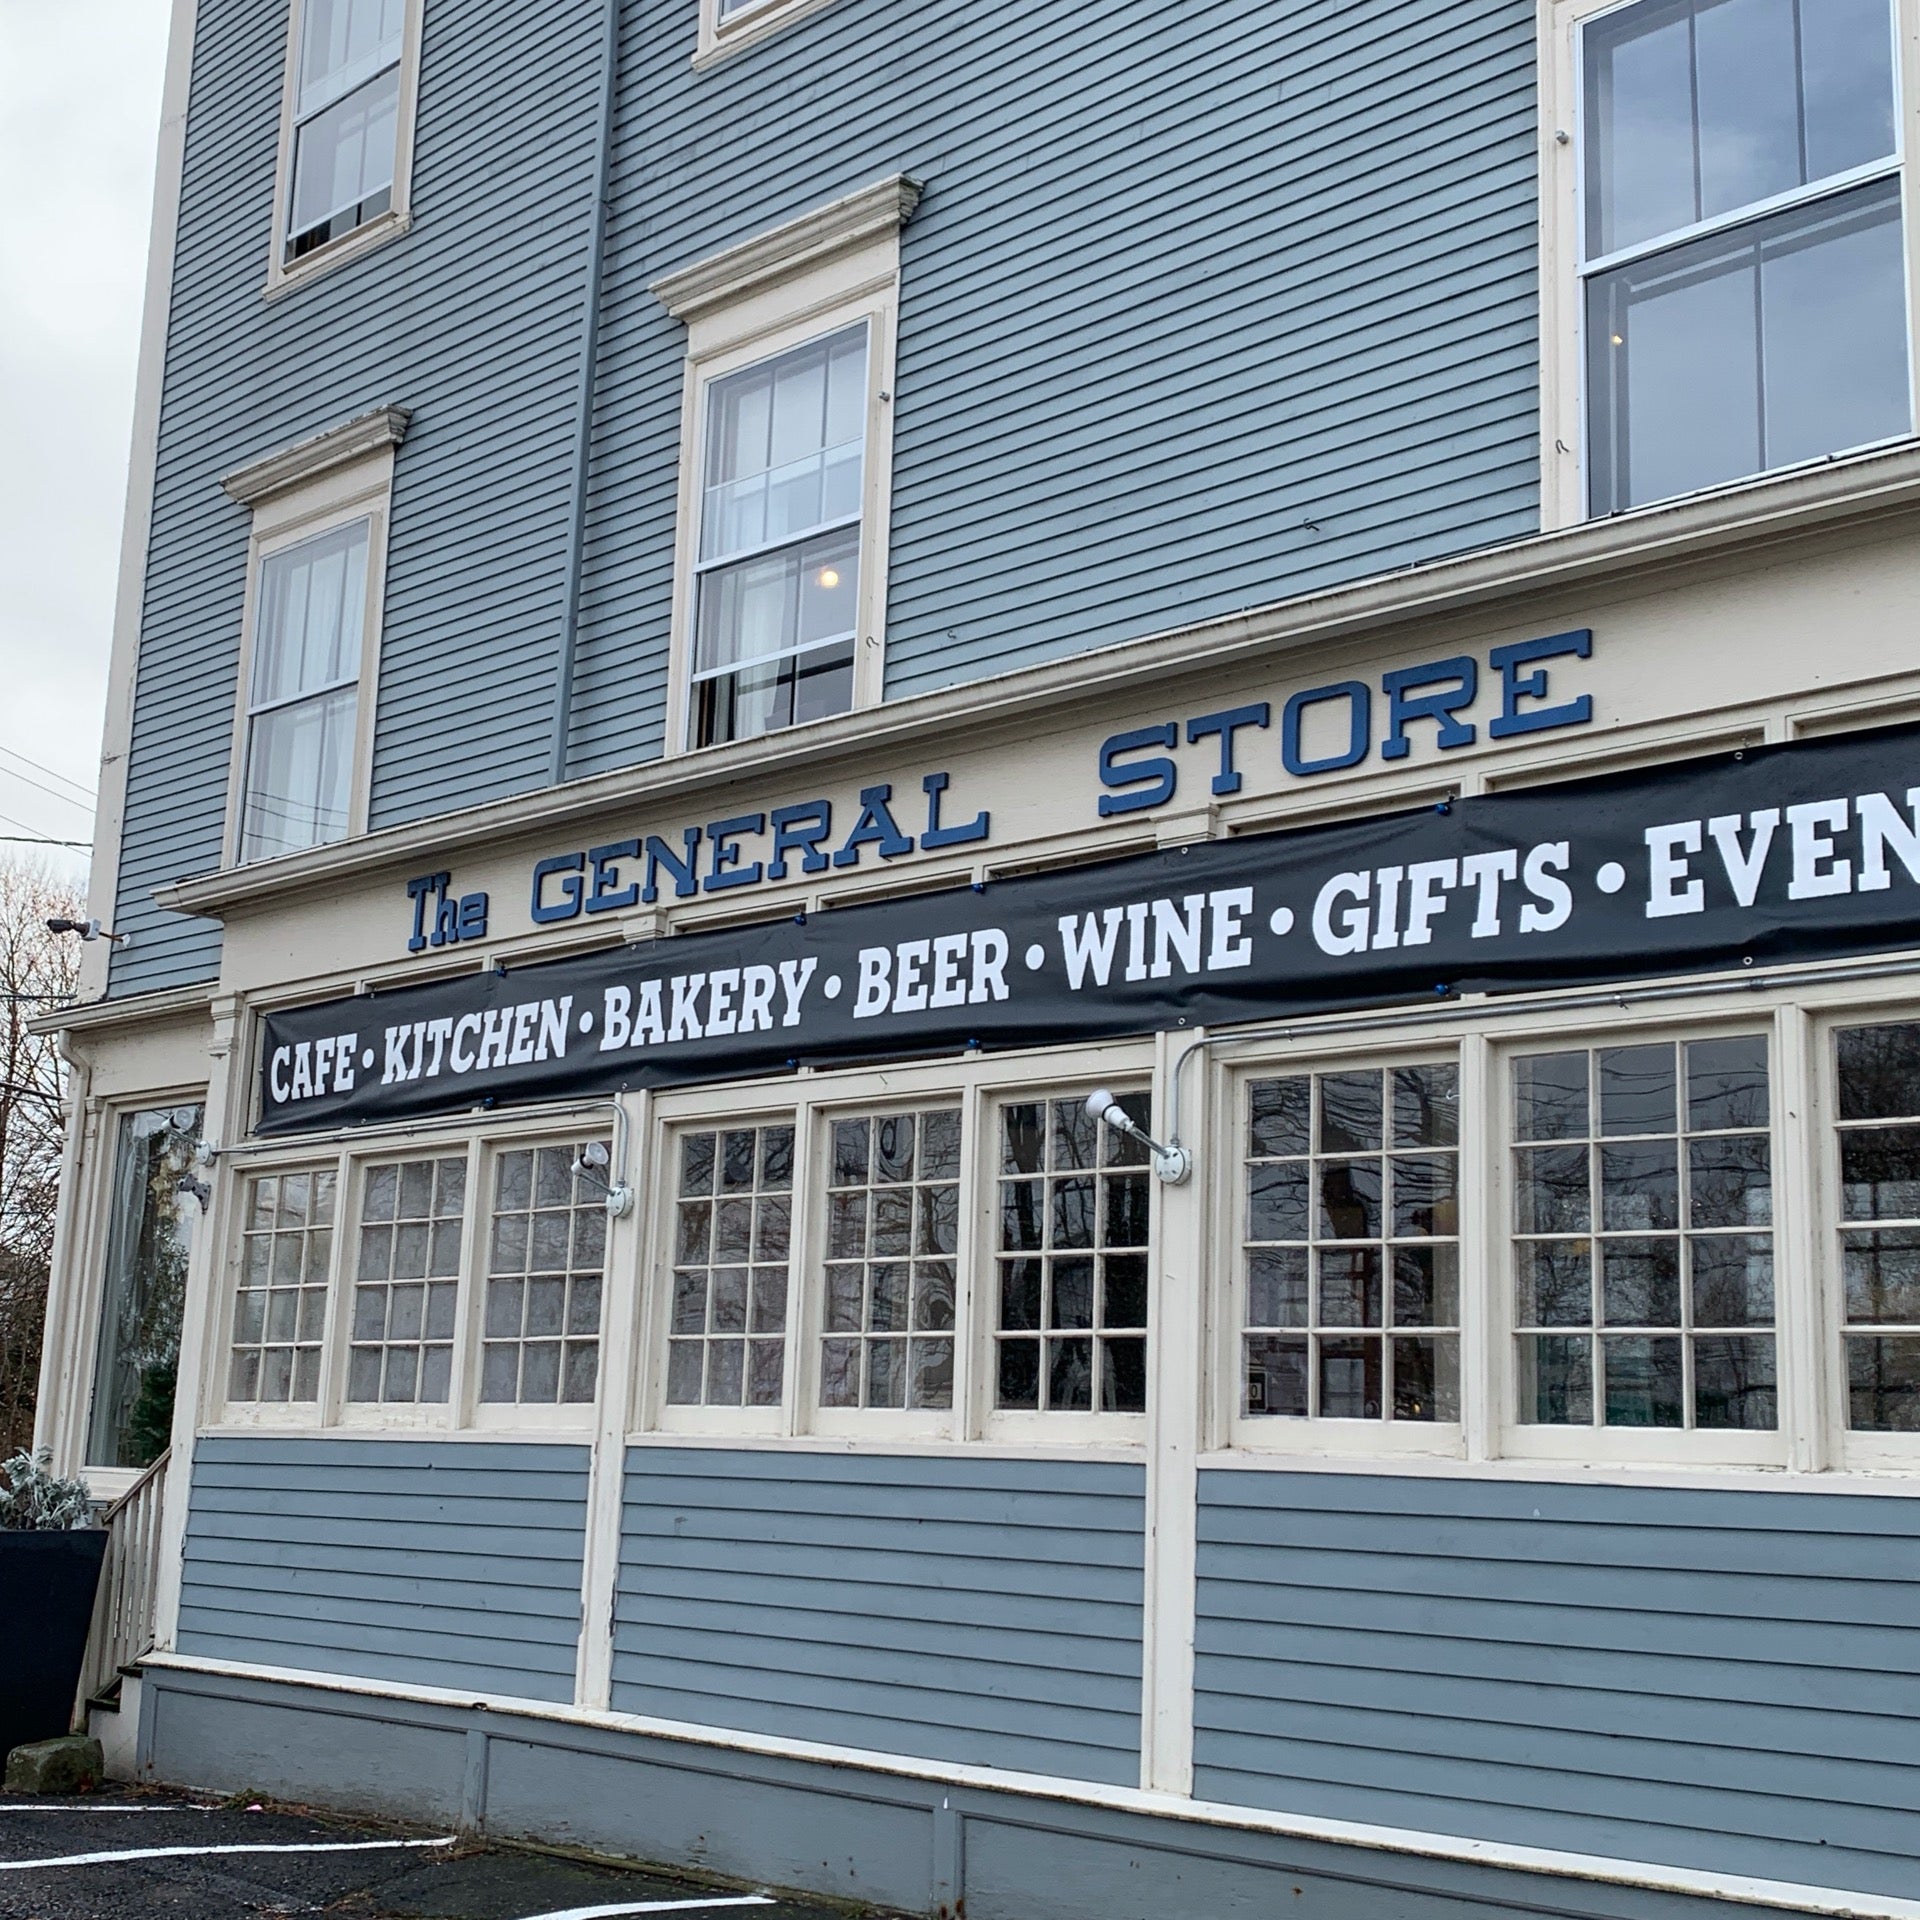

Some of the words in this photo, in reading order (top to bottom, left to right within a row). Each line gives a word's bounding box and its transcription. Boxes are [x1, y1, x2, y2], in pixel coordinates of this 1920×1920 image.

[270, 1032, 357, 1103] CAFE
[380, 995, 573, 1085] KITCHEN
[599, 956, 818, 1052] BAKERY
[853, 928, 1010, 1019] BEER
[1057, 886, 1254, 990] WINE
[1311, 841, 1573, 957] GIFTS
[1644, 786, 1920, 919] EVEN
[407, 871, 489, 952] The
[531, 772, 990, 924] GENERAL
[1097, 628, 1593, 817] STORE
